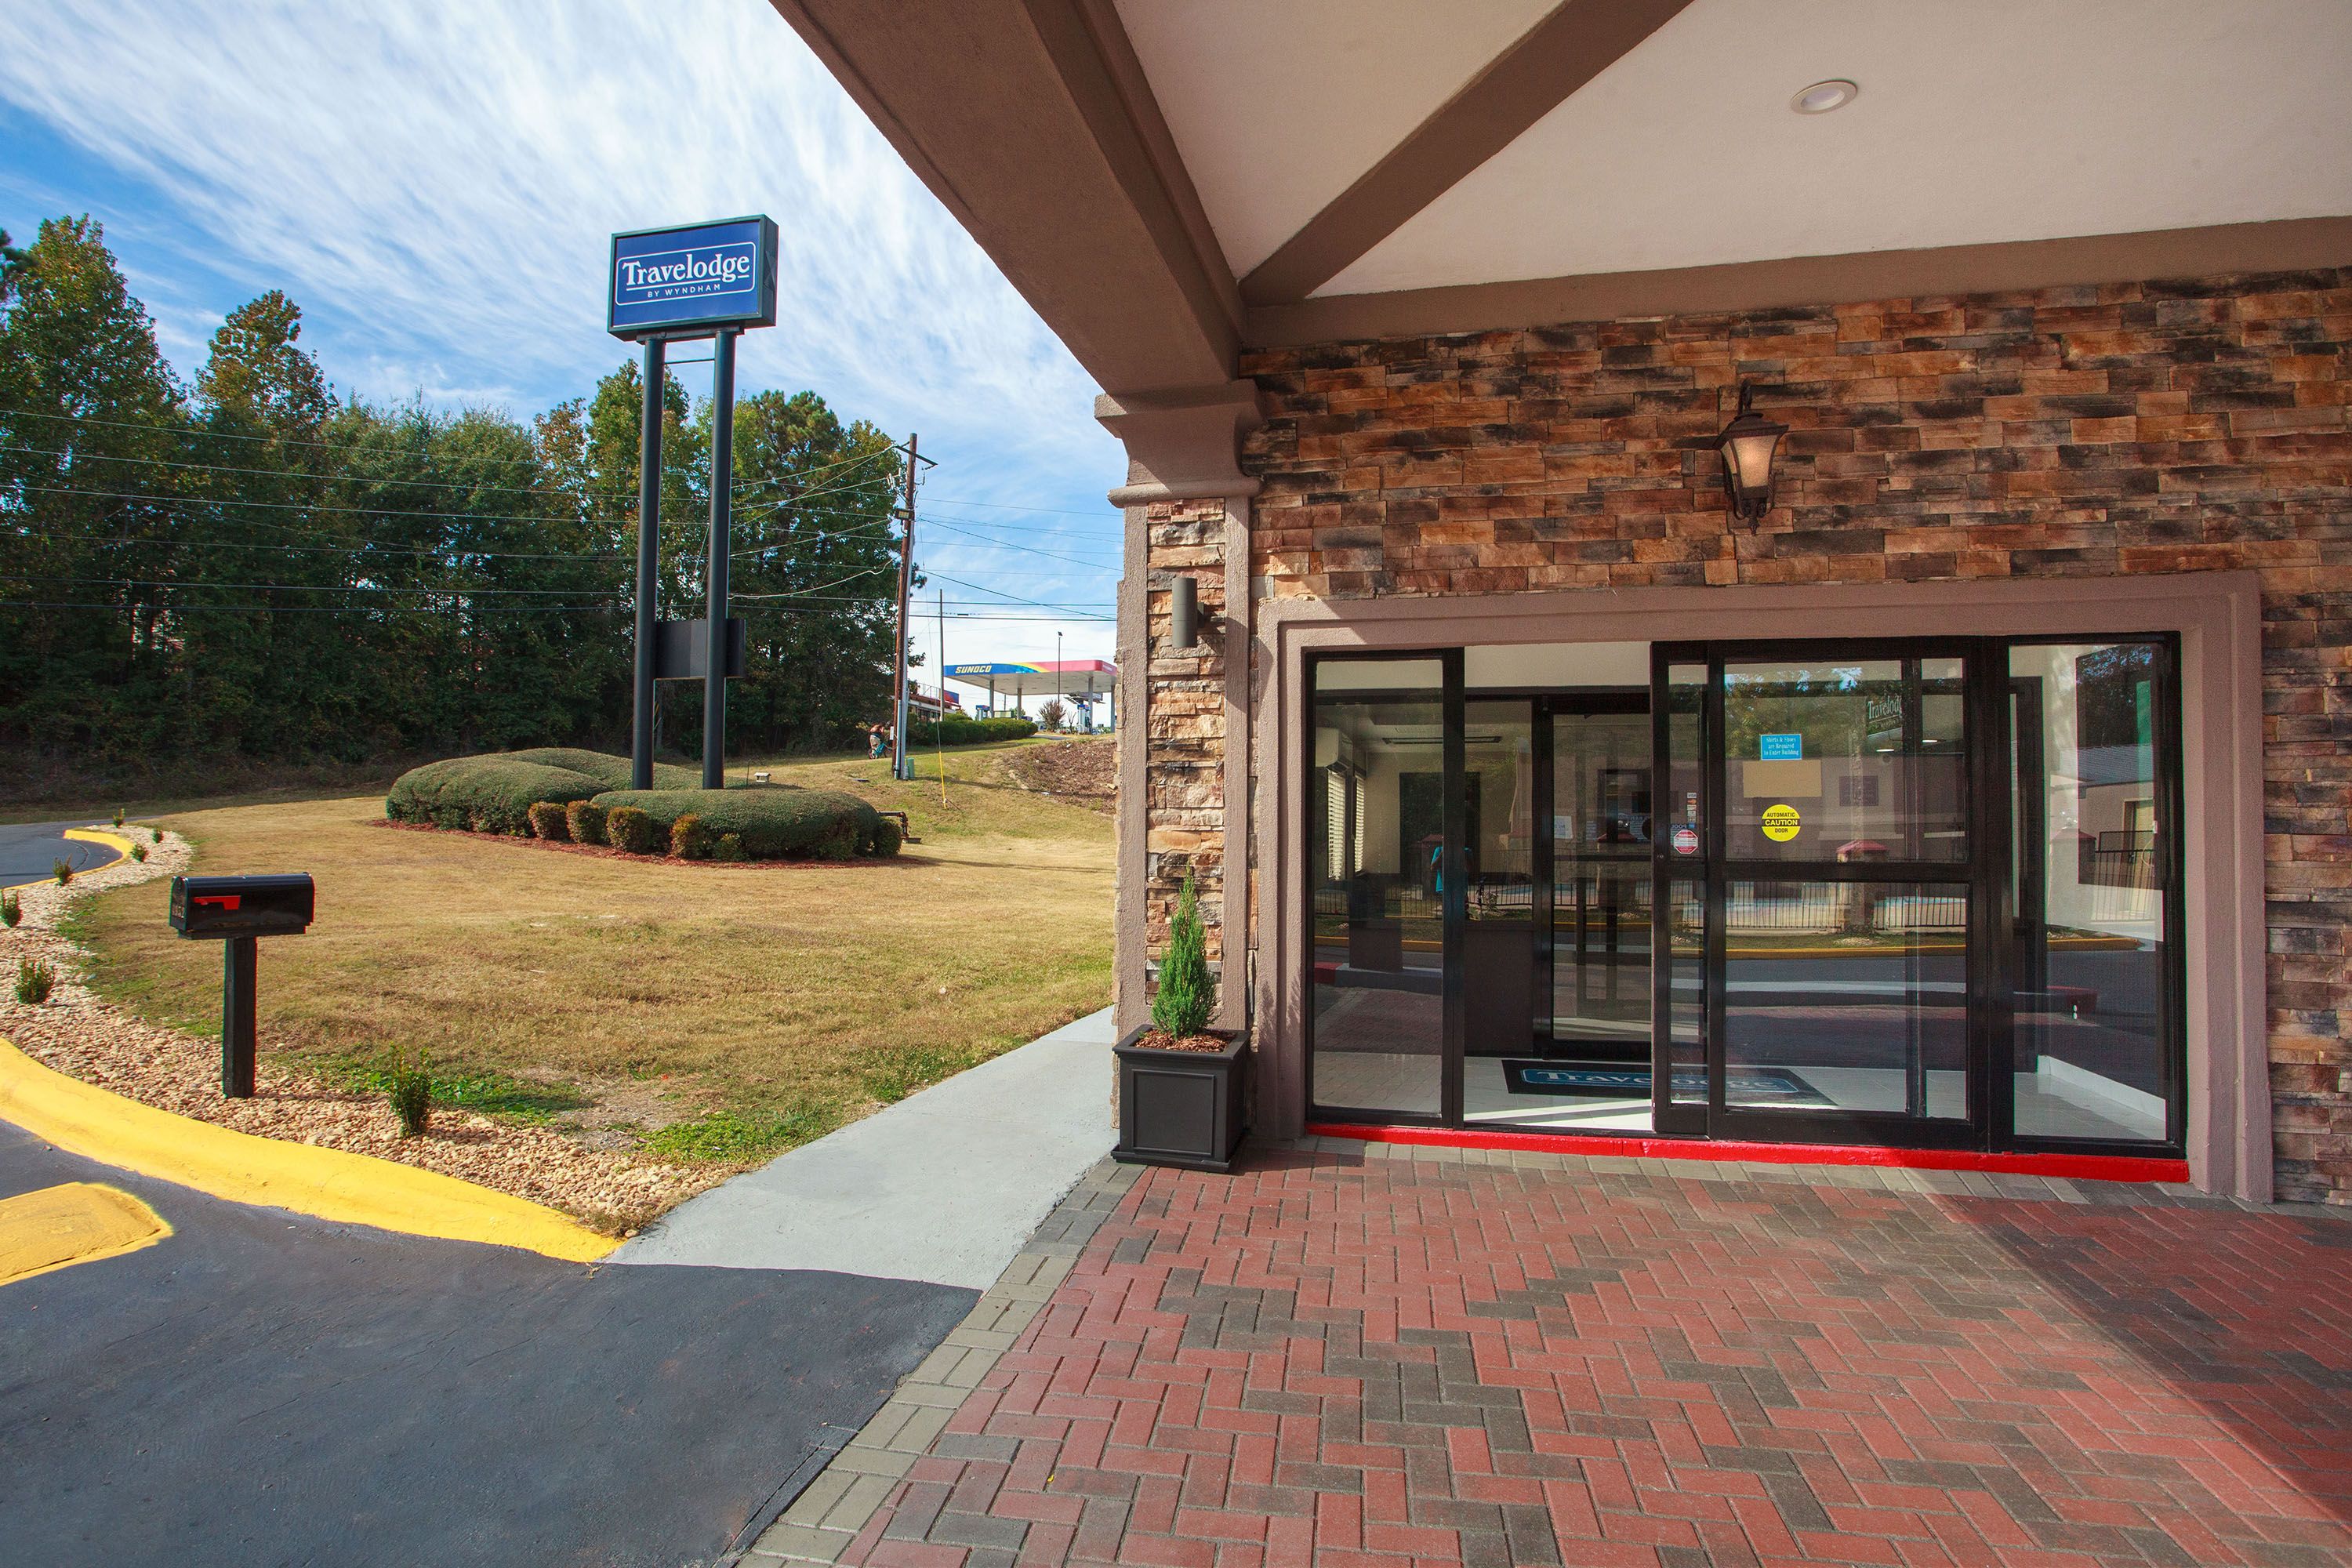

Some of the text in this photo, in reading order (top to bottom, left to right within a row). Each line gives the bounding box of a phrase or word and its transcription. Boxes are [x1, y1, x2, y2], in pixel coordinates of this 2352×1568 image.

[622, 253, 750, 285] Travelodge
[665, 284, 720, 296] WYNDHAM
[955, 665, 992, 673] SUNOCO
